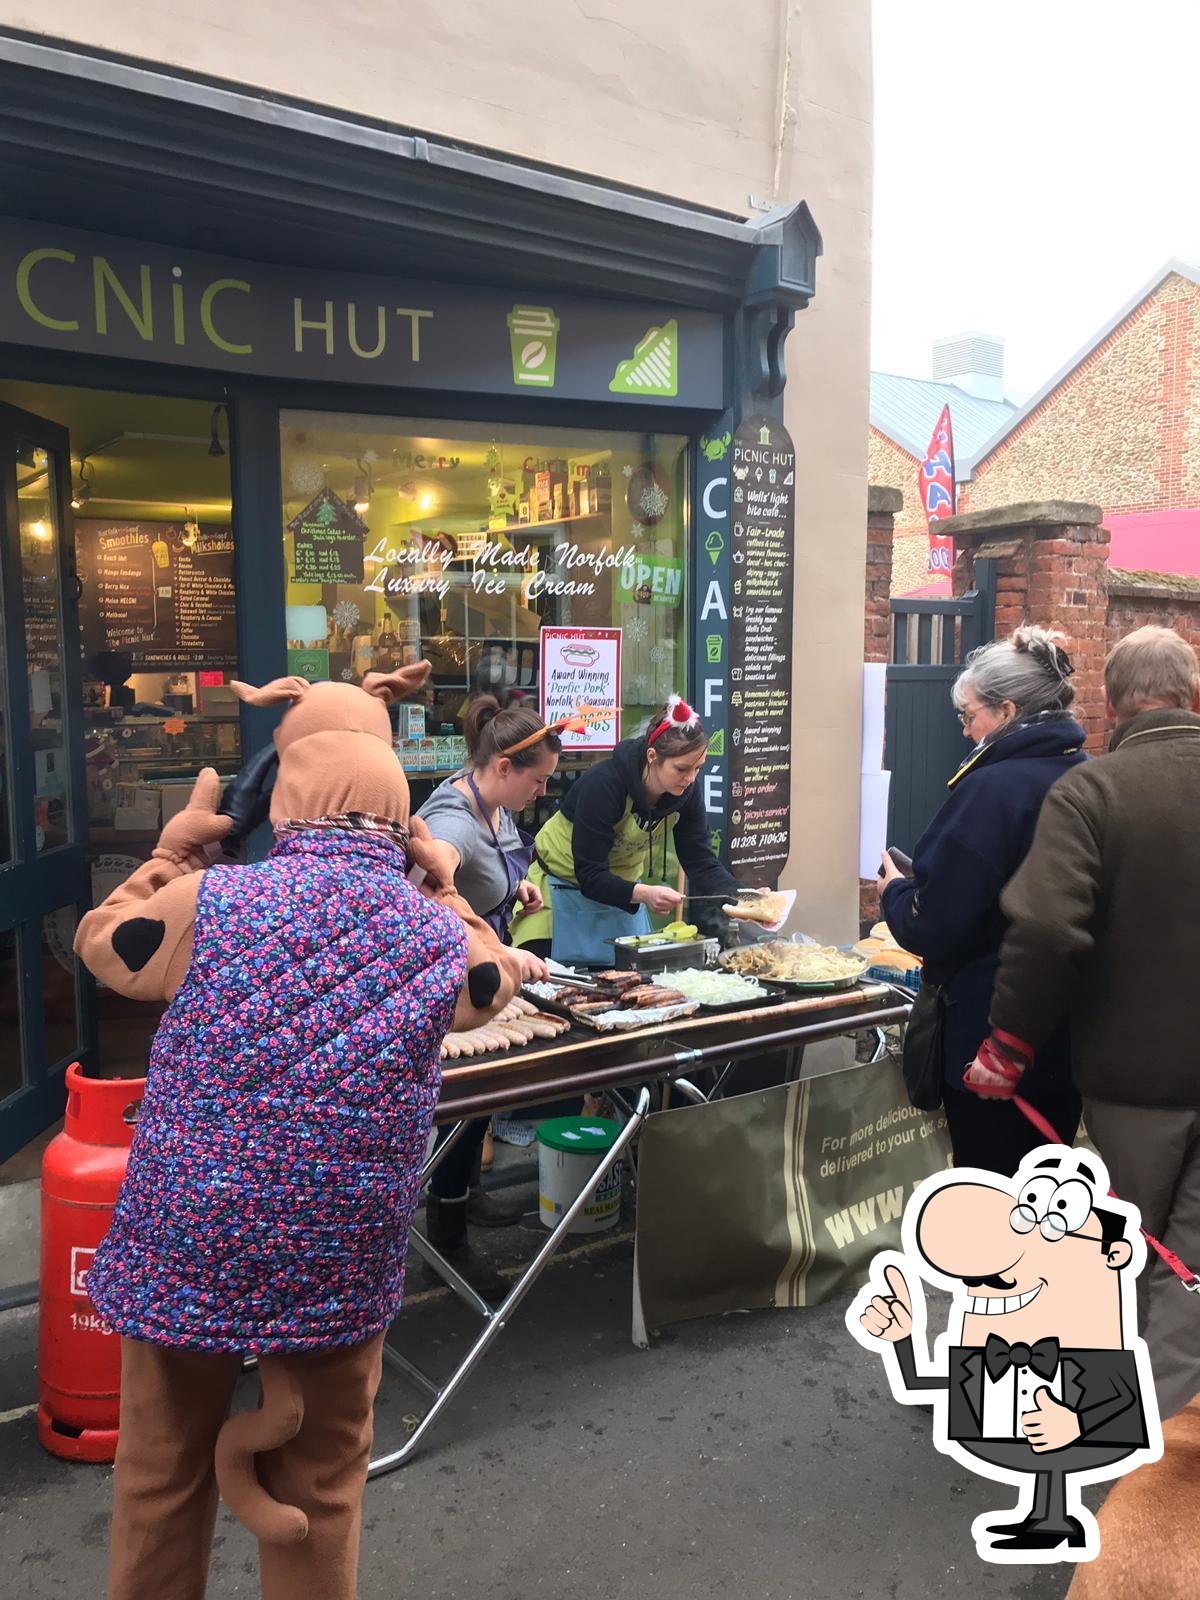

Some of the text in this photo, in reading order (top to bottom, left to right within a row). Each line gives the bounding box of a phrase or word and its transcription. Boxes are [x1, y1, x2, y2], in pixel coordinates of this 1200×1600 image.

[293, 298, 434, 362] HUT
[772, 452, 794, 467] HUT
[770, 491, 789, 506] light
[746, 503, 762, 516] bite
[99, 532, 150, 550] Smoothies
[746, 539, 765, 547] coffees
[191, 539, 235, 555] Milkshakes
[363, 537, 637, 576] Locally Made Norfolk
[363, 567, 596, 600] Luxury Ice Cream
[620, 564, 682, 595] OPEN
[765, 605, 783, 614] famous
[745, 615, 778, 625] freshly made
[106, 627, 135, 637] Welcome
[760, 624, 773, 633] Crab
[571, 633, 586, 641] HUT
[745, 634, 774, 643] sandwiches
[745, 643, 774, 654] many other
[745, 652, 786, 663] delicious fillings
[745, 662, 773, 671] salads and
[551, 669, 609, 683] Award Winning
[744, 690, 771, 698] Homemade
[546, 694, 574, 709] Norfolk
[584, 696, 615, 707] Sausage
[744, 708, 755, 717] and
[755, 708, 769, 716] much
[744, 726, 782, 735] Award winning
[753, 735, 769, 743] Cream
[744, 798, 754, 806] and
[731, 834, 758, 849] 01328
[821, 1135, 847, 1154] For
[849, 1122, 874, 1146] more
[820, 1141, 874, 1178] delivered
[875, 1141, 887, 1155] to
[887, 1127, 917, 1152] your
